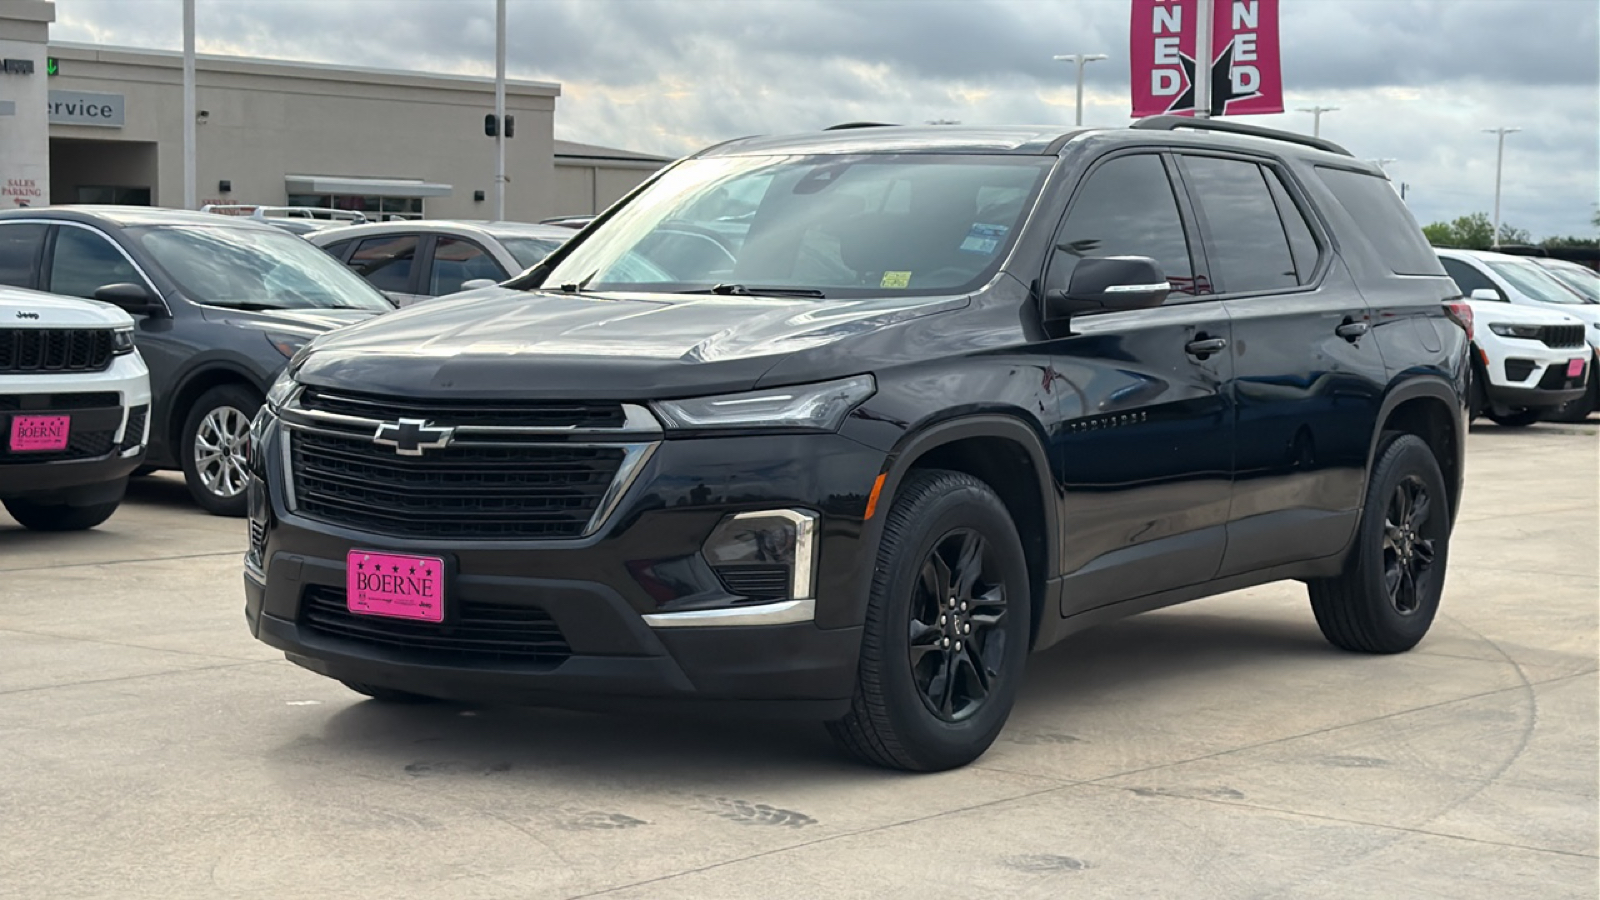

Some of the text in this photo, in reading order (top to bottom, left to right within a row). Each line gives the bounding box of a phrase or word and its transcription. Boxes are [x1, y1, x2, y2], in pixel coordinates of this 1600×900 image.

[1152, 0, 1181, 96] NED
[48, 99, 113, 118] rvice
[8, 179, 35, 187] SALES
[2, 187, 41, 196] PARKING
[15, 310, 40, 320] Jeep
[357, 572, 433, 597] BOERNE
